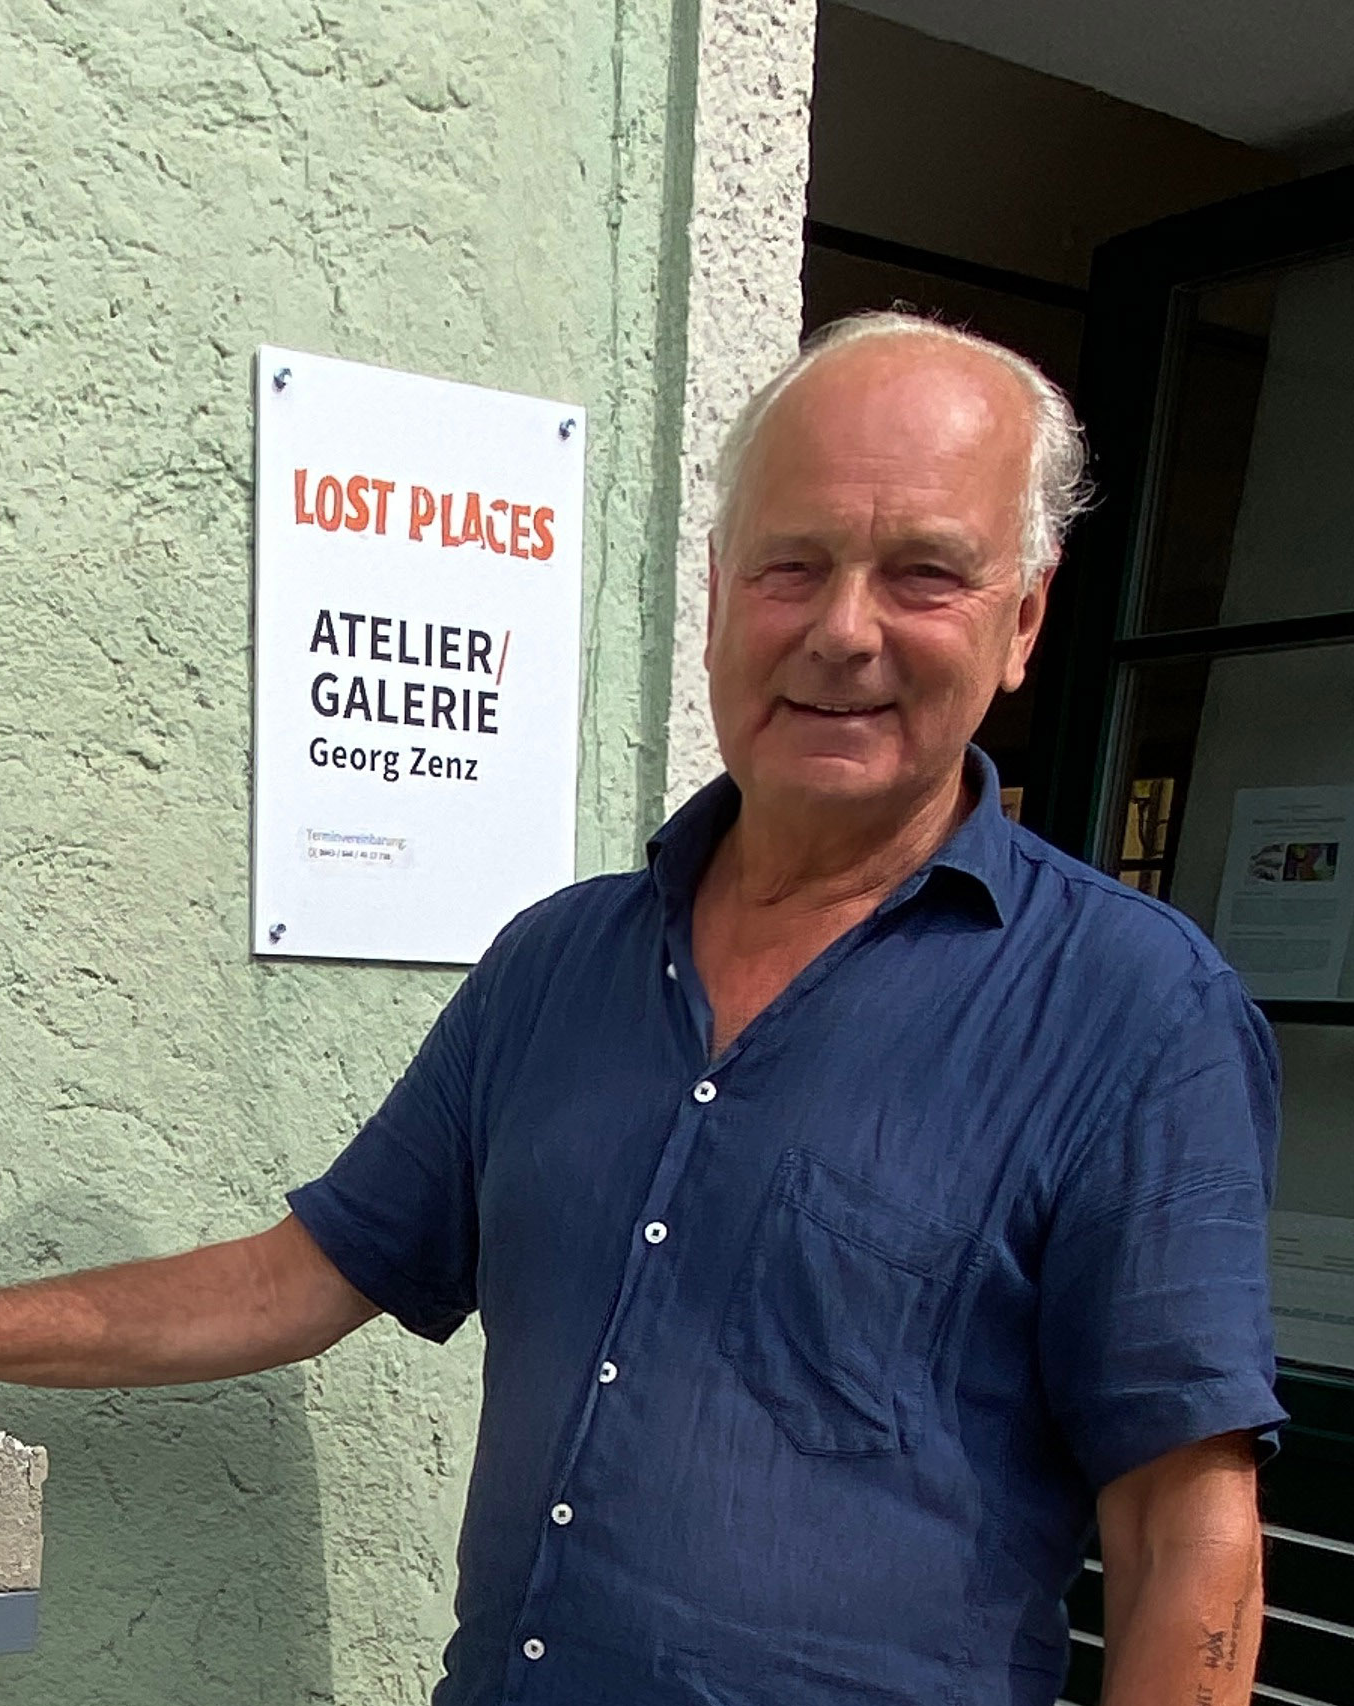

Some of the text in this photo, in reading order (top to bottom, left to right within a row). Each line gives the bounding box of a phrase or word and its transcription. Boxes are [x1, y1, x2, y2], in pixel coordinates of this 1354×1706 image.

[294, 467, 555, 562] LOST PLACES
[308, 608, 512, 686] ATELIER/
[310, 671, 499, 735] GALERIE
[308, 736, 479, 783] Georg Zenz
